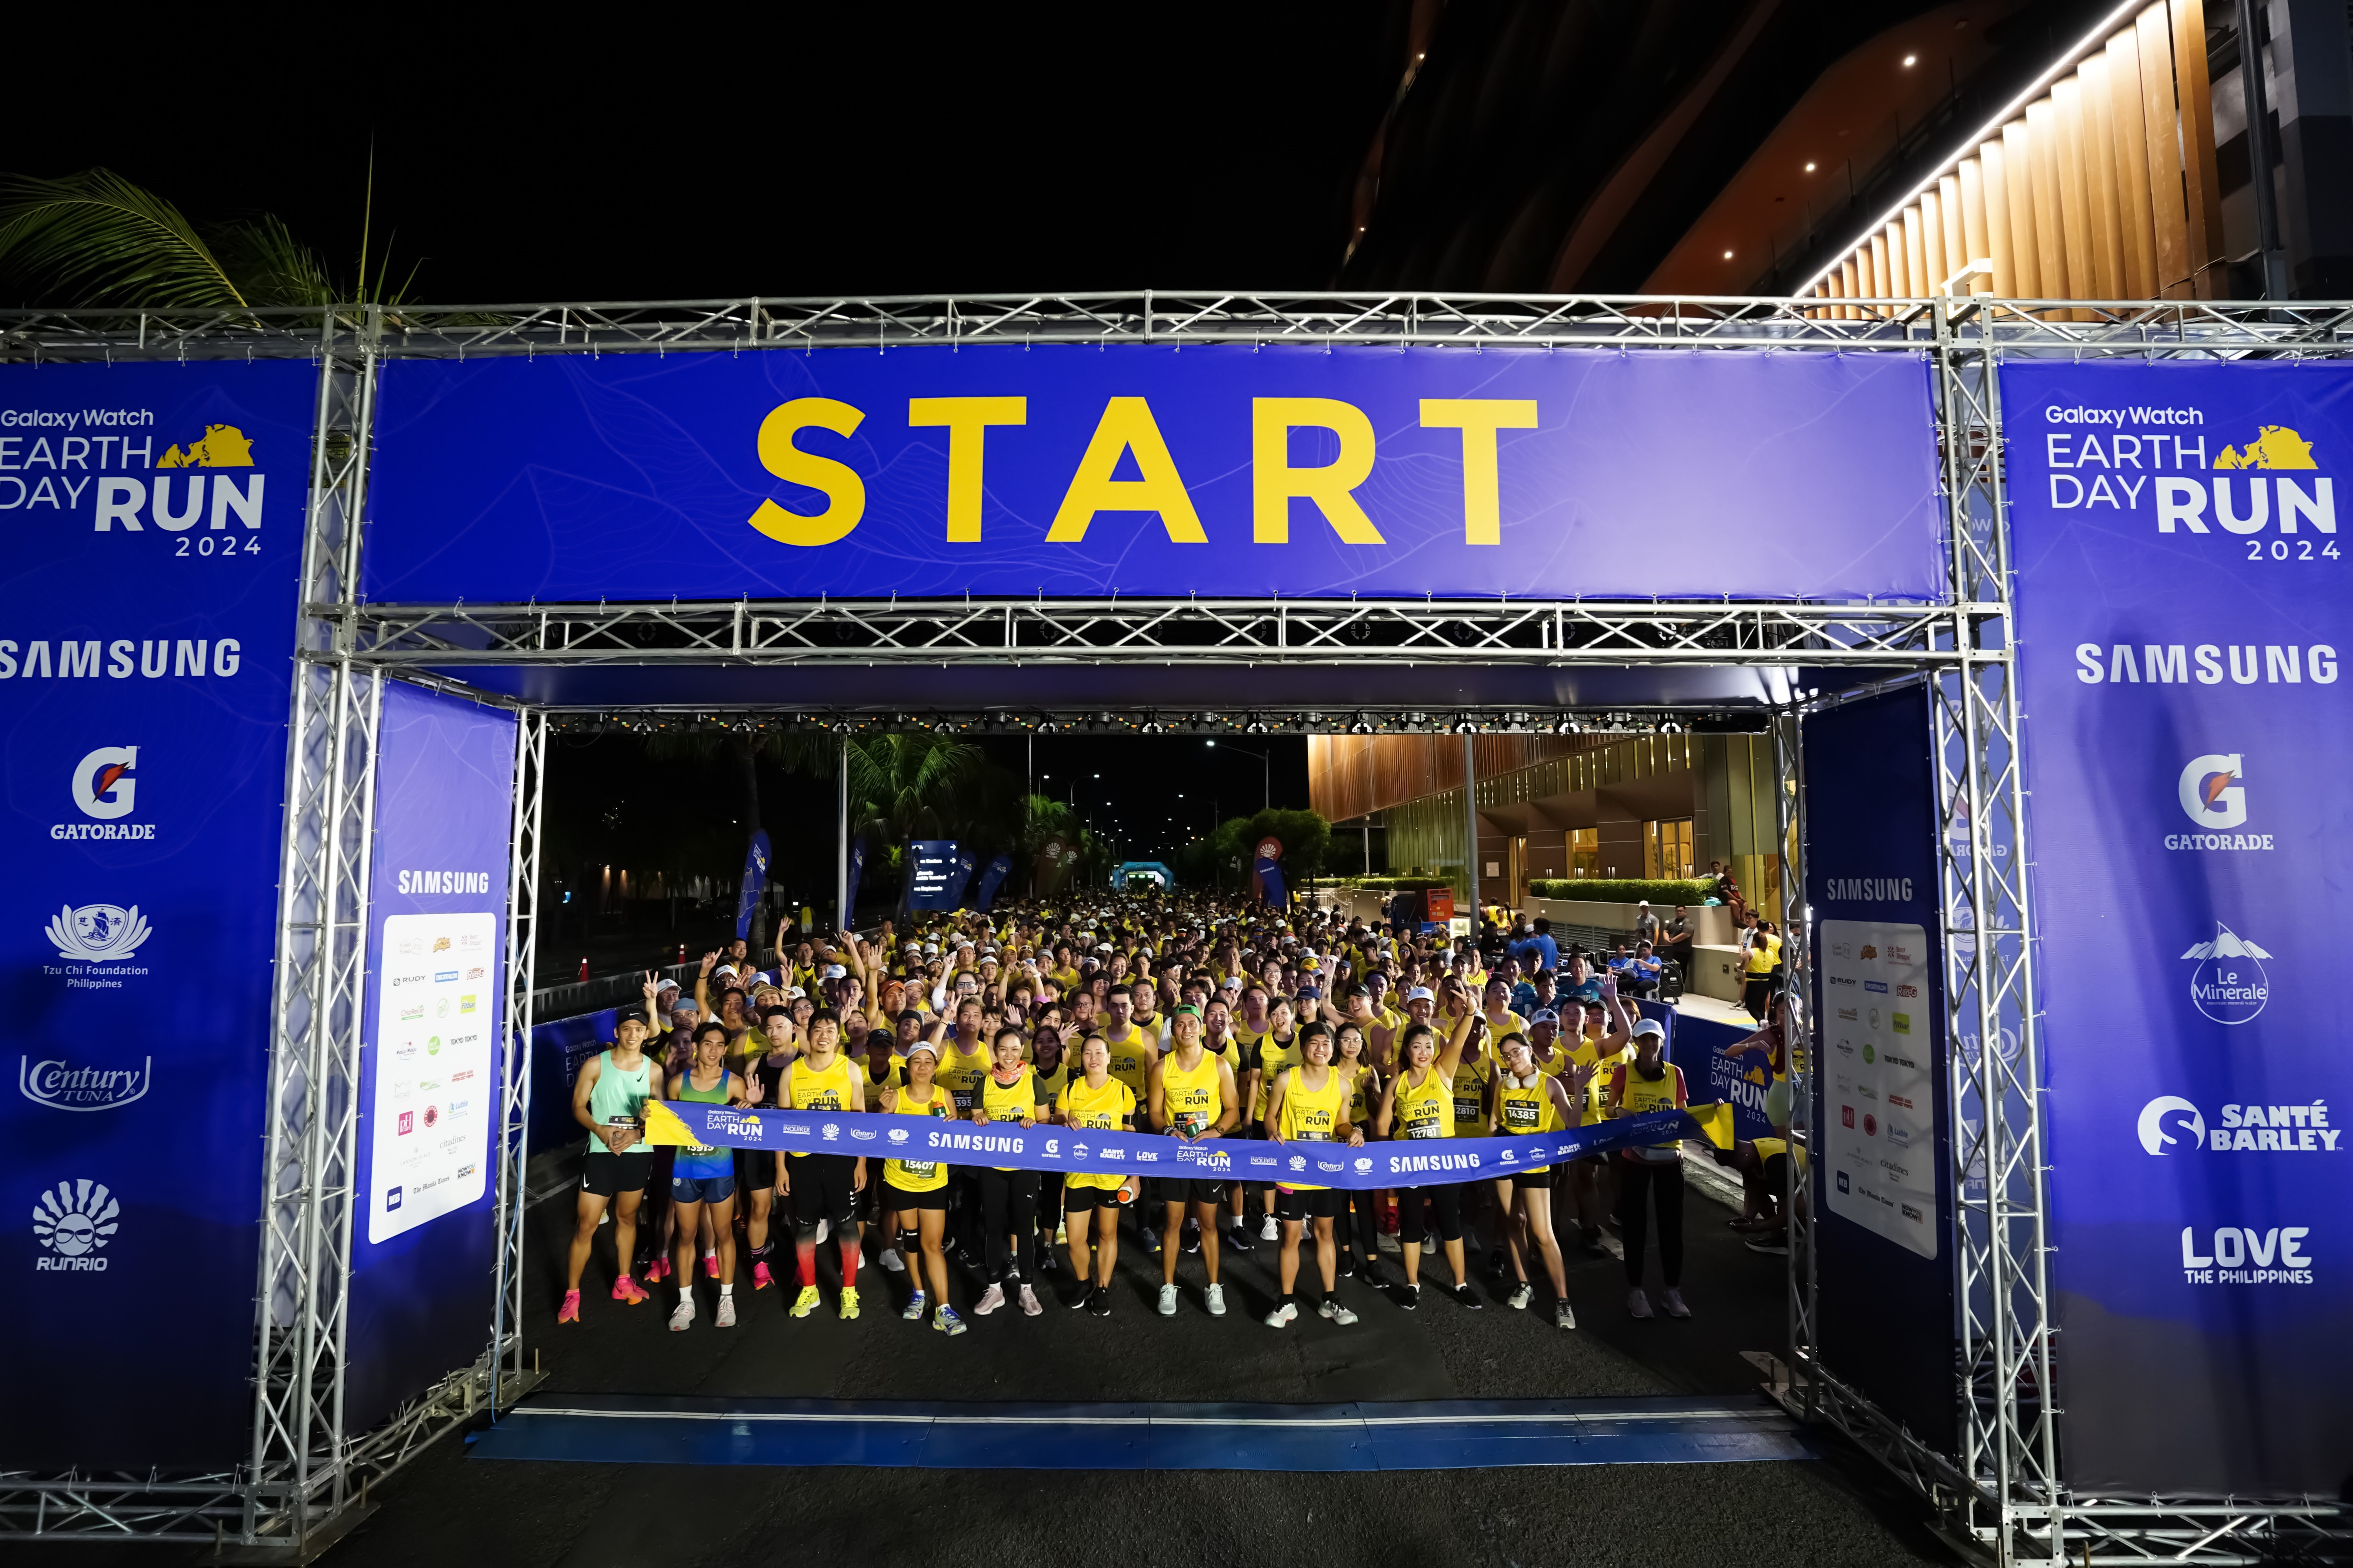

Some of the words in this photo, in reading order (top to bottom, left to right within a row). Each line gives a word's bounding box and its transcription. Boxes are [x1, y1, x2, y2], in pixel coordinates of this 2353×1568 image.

[1, 410, 80, 431] Galaxy
[83, 409, 153, 426] Watch
[2045, 405, 2126, 429] Galaxy
[2128, 407, 2204, 425] Watch
[0, 436, 152, 470] EARTH
[2047, 434, 2206, 469] EARTH
[747, 396, 1538, 547] START
[0, 476, 91, 509] DAY
[94, 474, 265, 532] RUN
[2050, 474, 2147, 510] DAY
[2155, 477, 2337, 534] RUN
[175, 536, 261, 556] 2024
[2247, 540, 2340, 560] 2024
[0, 639, 240, 679] SAMSUNG
[2075, 643, 2338, 685] SAMSUNG
[50, 824, 155, 840] GATORADE
[2164, 834, 2274, 850] GATORADE
[398, 870, 489, 894] SAMSUNG
[1827, 878, 1913, 901] SAMSUNG
[43, 965, 62, 975] Tzu
[66, 966, 83, 975] Chi
[86, 966, 148, 975] Foundation
[2217, 968, 2237, 985] Le
[67, 978, 122, 990] Philippines
[2193, 983, 2267, 1000] Minerale
[461, 1001, 475, 1010] Fitbar
[1893, 1020, 1909, 1030] Fitbar
[450, 1037, 464, 1045] TOKYO
[465, 1034, 477, 1043] TOKYO
[582, 1039, 596, 1049] Watch
[1115, 1063, 1136, 1071] RUN
[1712, 1056, 1743, 1078] EARTH
[1884, 1055, 1898, 1065] TOKYO
[1899, 1058, 1915, 1068] TOKYO
[29, 1060, 140, 1098] Century
[64, 1090, 114, 1101] TUNA
[1711, 1071, 1730, 1089] DAY
[1730, 1078, 1767, 1113] RUN
[455, 1100, 468, 1110] Lubie
[1185, 1096, 1209, 1105] RUN
[1414, 1105, 1440, 1117] RUN
[1508, 1109, 1536, 1120] 14385
[1649, 1104, 1673, 1113] RUN
[2222, 1099, 2329, 1128] SANTÉ
[707, 1115, 740, 1123] EARTH
[1305, 1116, 1330, 1125] RUN
[1747, 1110, 1766, 1124] 2024
[728, 1123, 763, 1136] RUN
[1087, 1121, 1111, 1129] RUN
[852, 1129, 874, 1138] Century
[1411, 1128, 1437, 1139] 12781
[1894, 1127, 1908, 1139] Lubie
[440, 1134, 466, 1149] citadines
[929, 1132, 1024, 1154] SAMSUNG
[2210, 1130, 2341, 1151] BARLEY
[400, 1157, 417, 1166] LANSON
[418, 1152, 431, 1160] PLACE
[1137, 1150, 1158, 1159] LOVE
[905, 1159, 935, 1170] 15407
[1197, 1157, 1231, 1167] RUN
[1320, 1162, 1341, 1171] Century
[1390, 1153, 1480, 1173] SAMSUNG
[1881, 1159, 1908, 1176] citadines
[458, 1170, 472, 1180] KNOW
[389, 1193, 400, 1206] MB
[1902, 1211, 1918, 1221] KNOW
[2182, 1226, 2312, 1268] LOVE
[36, 1257, 107, 1271] RUNRIO
[2184, 1270, 2213, 1284] THE
[2219, 1270, 2313, 1284] PHILIPPINES
